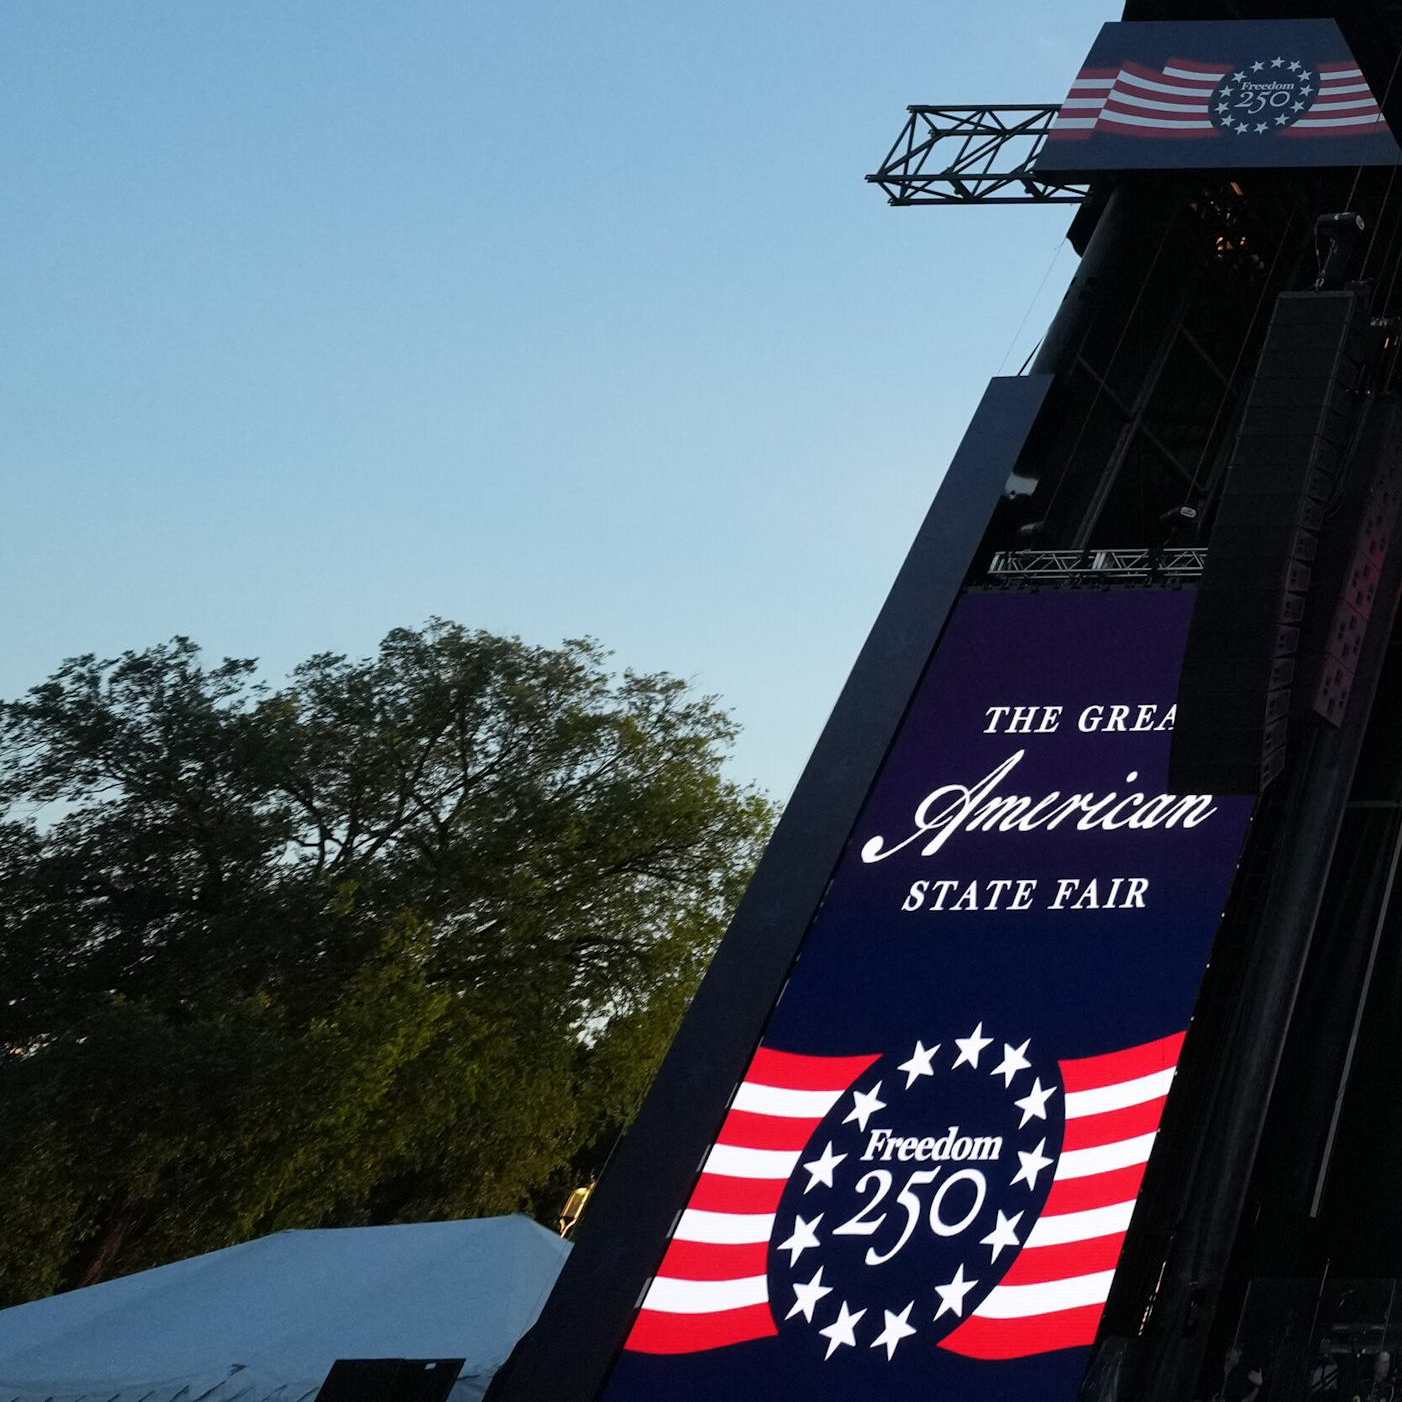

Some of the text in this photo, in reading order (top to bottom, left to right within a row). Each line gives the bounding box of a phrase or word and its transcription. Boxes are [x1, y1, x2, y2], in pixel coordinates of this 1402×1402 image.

[1233, 90, 1291, 114] 250
[1240, 81, 1294, 91] Freedom
[983, 703, 1177, 734] THE GREA
[860, 749, 1218, 864] American
[901, 877, 1149, 912] STATE FAIR
[859, 1126, 1003, 1161] Freedom
[832, 1165, 987, 1266] 250
